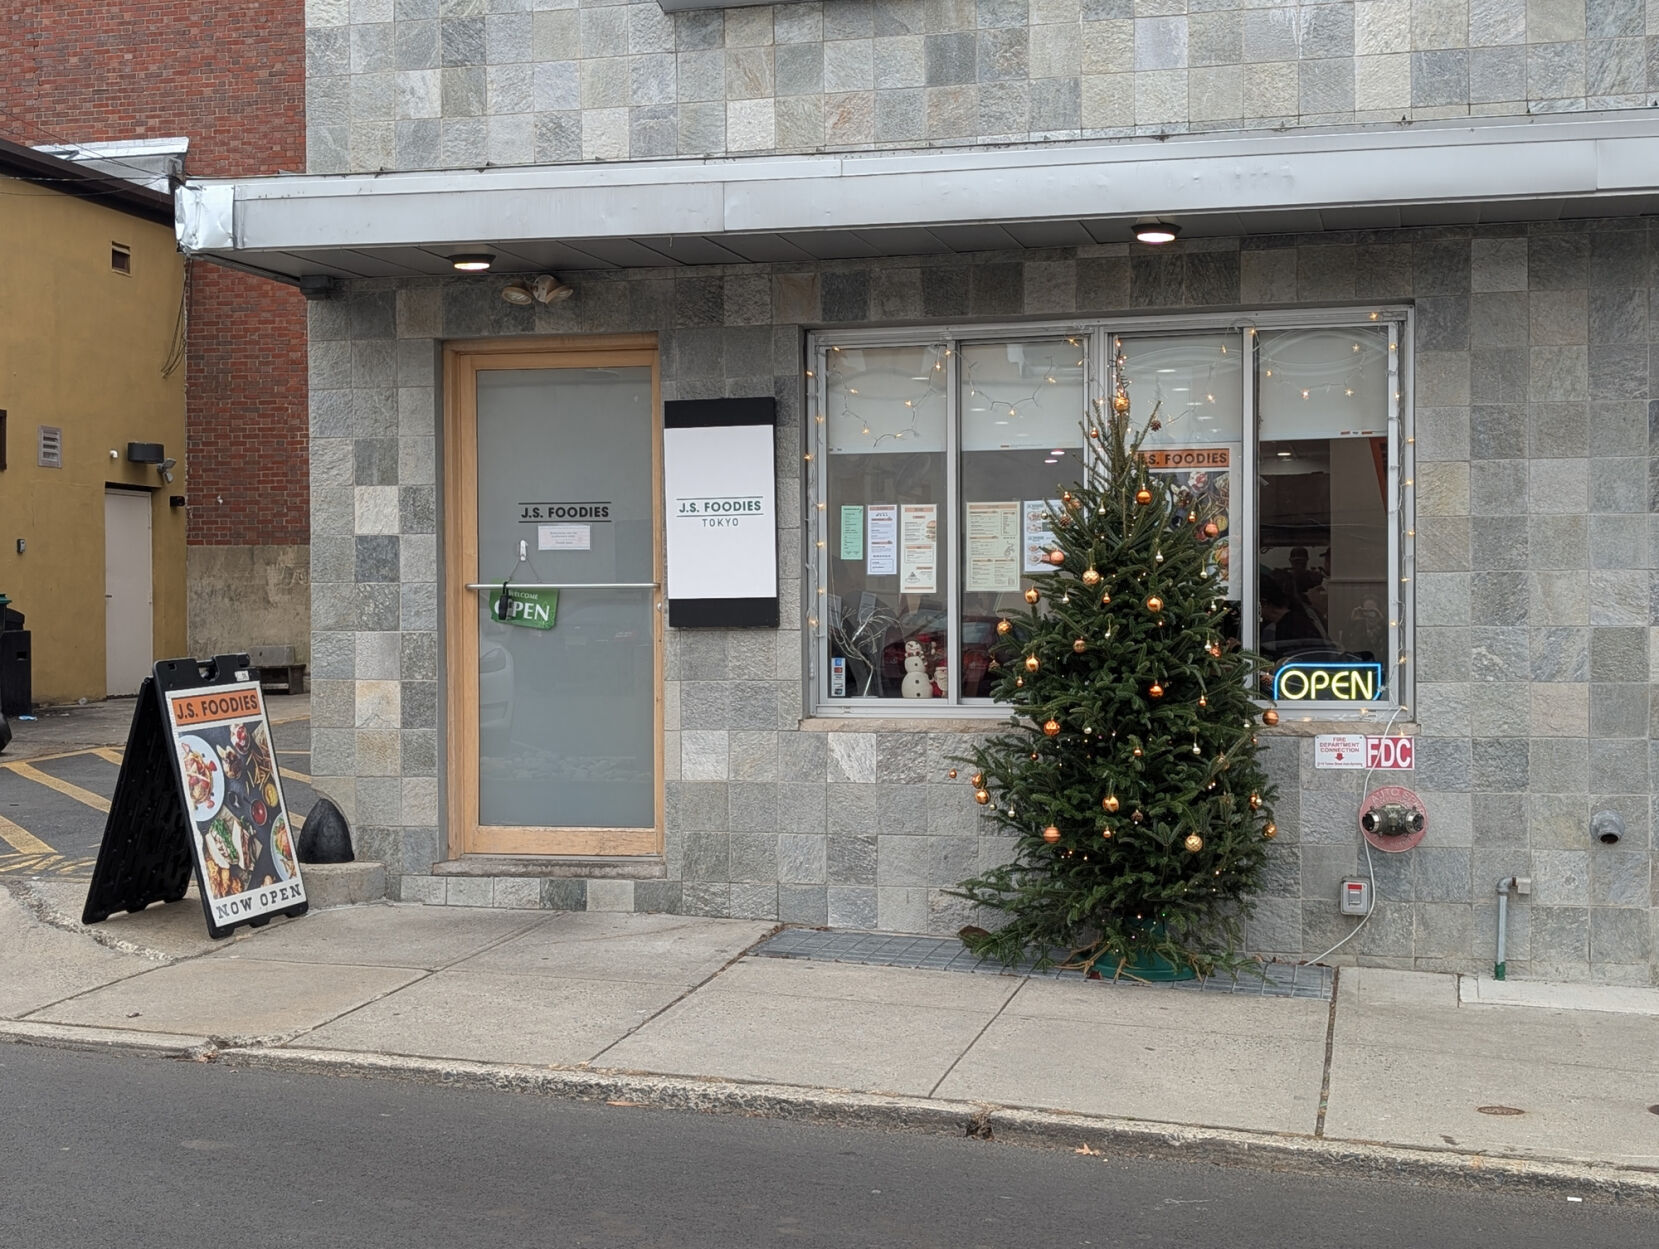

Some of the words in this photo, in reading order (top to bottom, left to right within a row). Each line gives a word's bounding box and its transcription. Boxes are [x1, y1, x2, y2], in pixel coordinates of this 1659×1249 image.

[1164, 452, 1227, 465] FOODIES
[521, 507, 544, 519] J.S.
[548, 506, 609, 518] FOODIES
[679, 502, 700, 513] J.S.
[704, 500, 762, 512] FOODIES
[702, 518, 739, 527] TOKYO
[1280, 670, 1373, 700] OPEN
[177, 702, 199, 719] J.S.
[201, 694, 258, 716] FOODIES
[1367, 738, 1411, 767] FDC
[216, 897, 253, 919] NOW
[260, 884, 302, 906] OPEN
